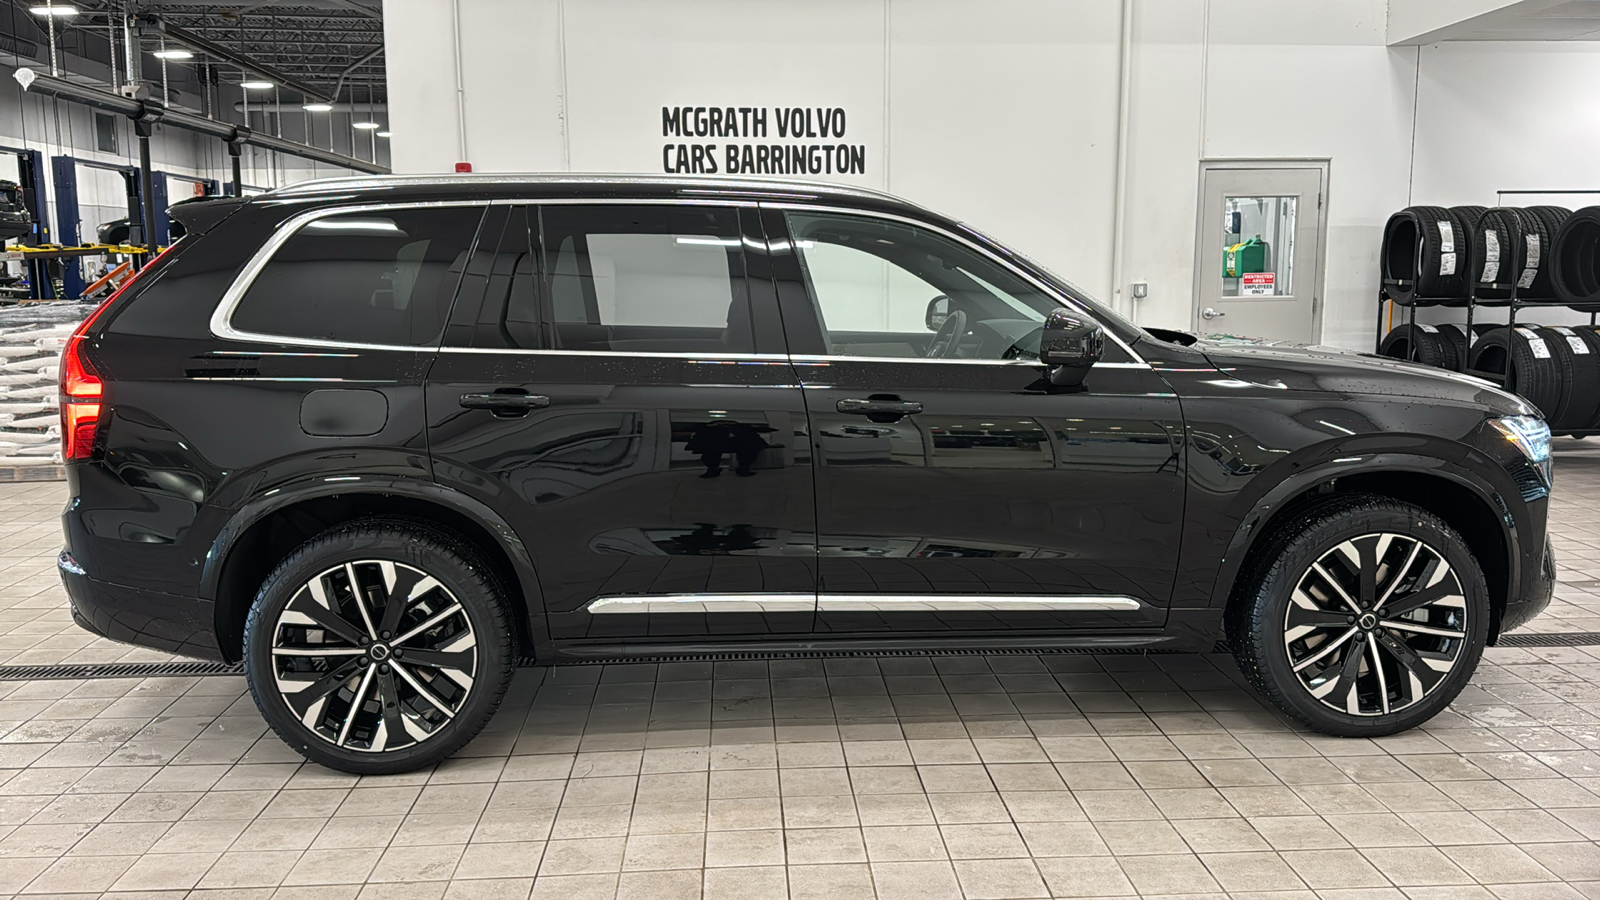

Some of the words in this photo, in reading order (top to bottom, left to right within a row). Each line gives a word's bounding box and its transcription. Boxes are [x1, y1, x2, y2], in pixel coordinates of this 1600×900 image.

[662, 106, 767, 137] MCGRATH
[775, 107, 846, 138] VOLVO
[663, 144, 718, 174] CARS
[726, 144, 865, 174] BARRINGTON
